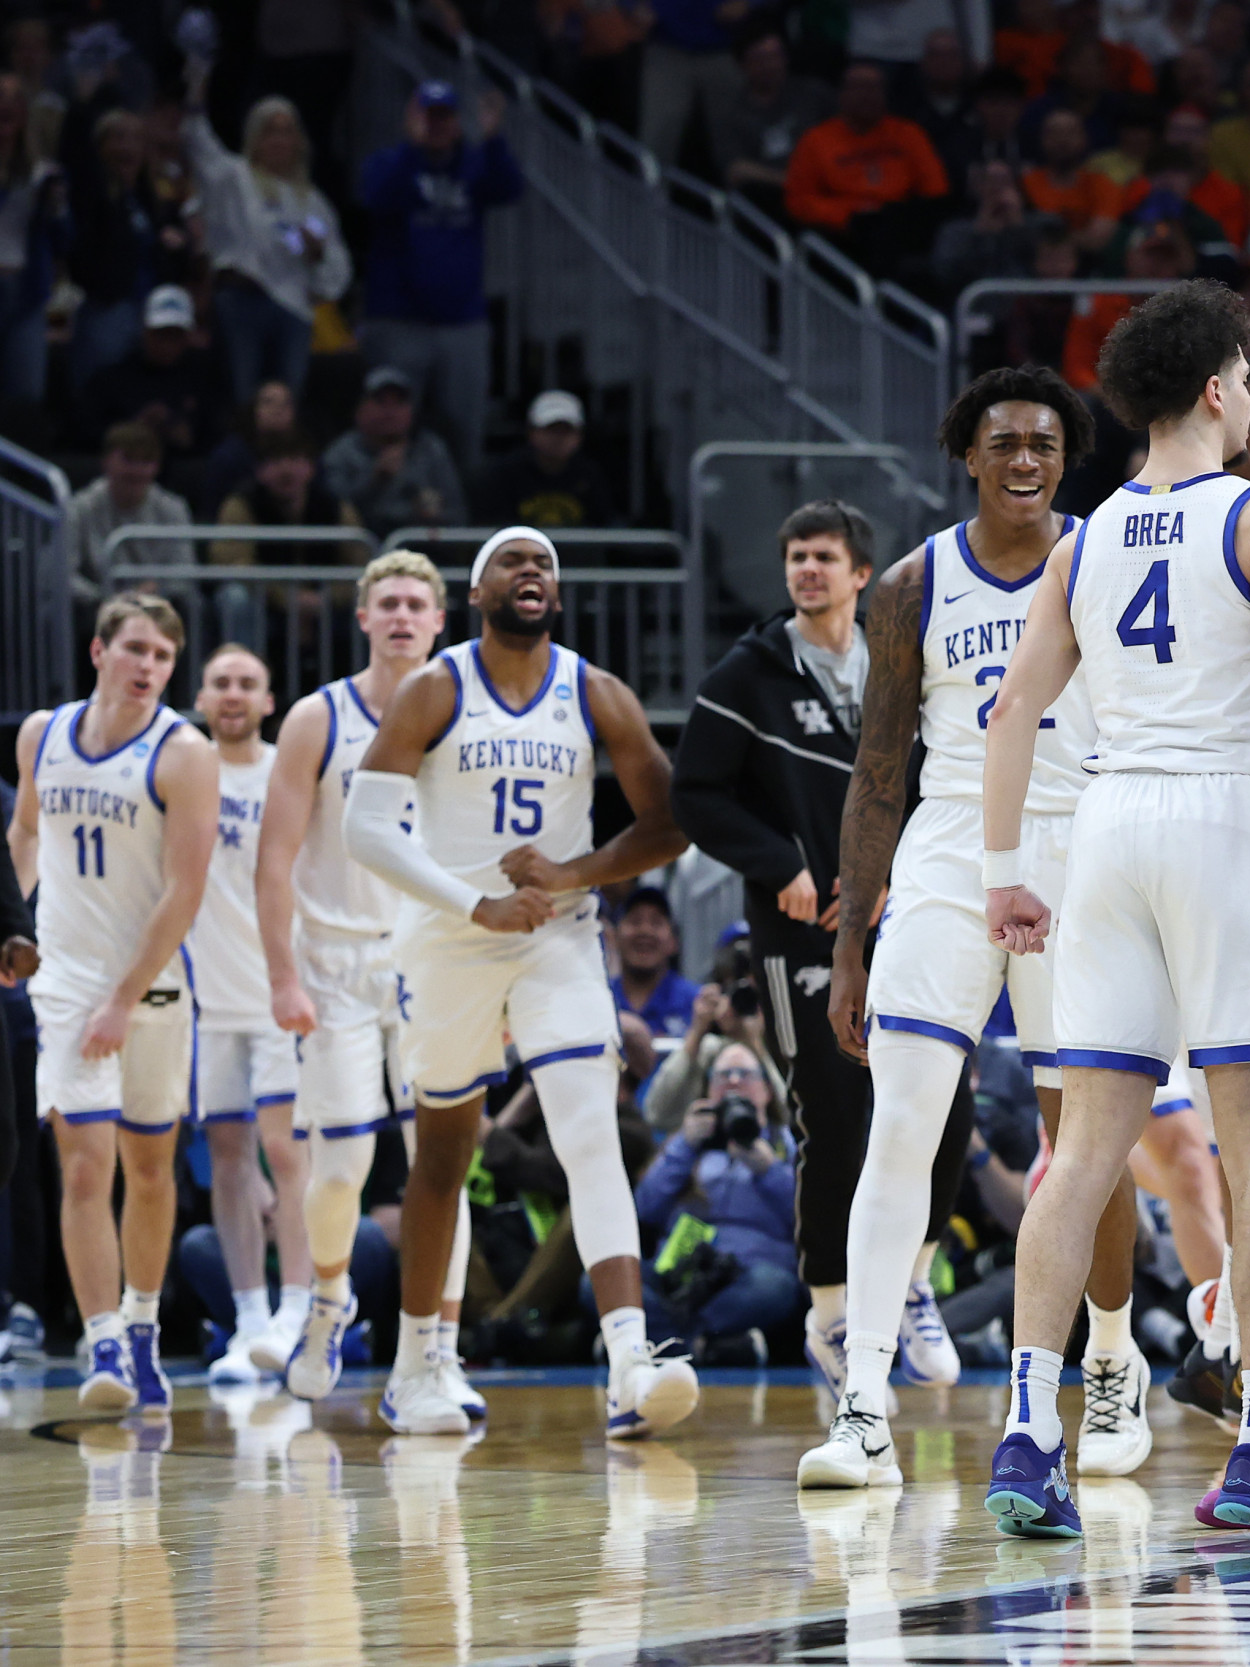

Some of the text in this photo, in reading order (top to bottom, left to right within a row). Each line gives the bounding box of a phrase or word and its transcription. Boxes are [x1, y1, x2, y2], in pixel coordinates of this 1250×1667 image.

[1124, 511, 1184, 547] BREA
[1116, 559, 1176, 664] 4
[459, 740, 577, 777] KENTUCKY
[491, 777, 545, 836] 15
[73, 823, 105, 878] 11
